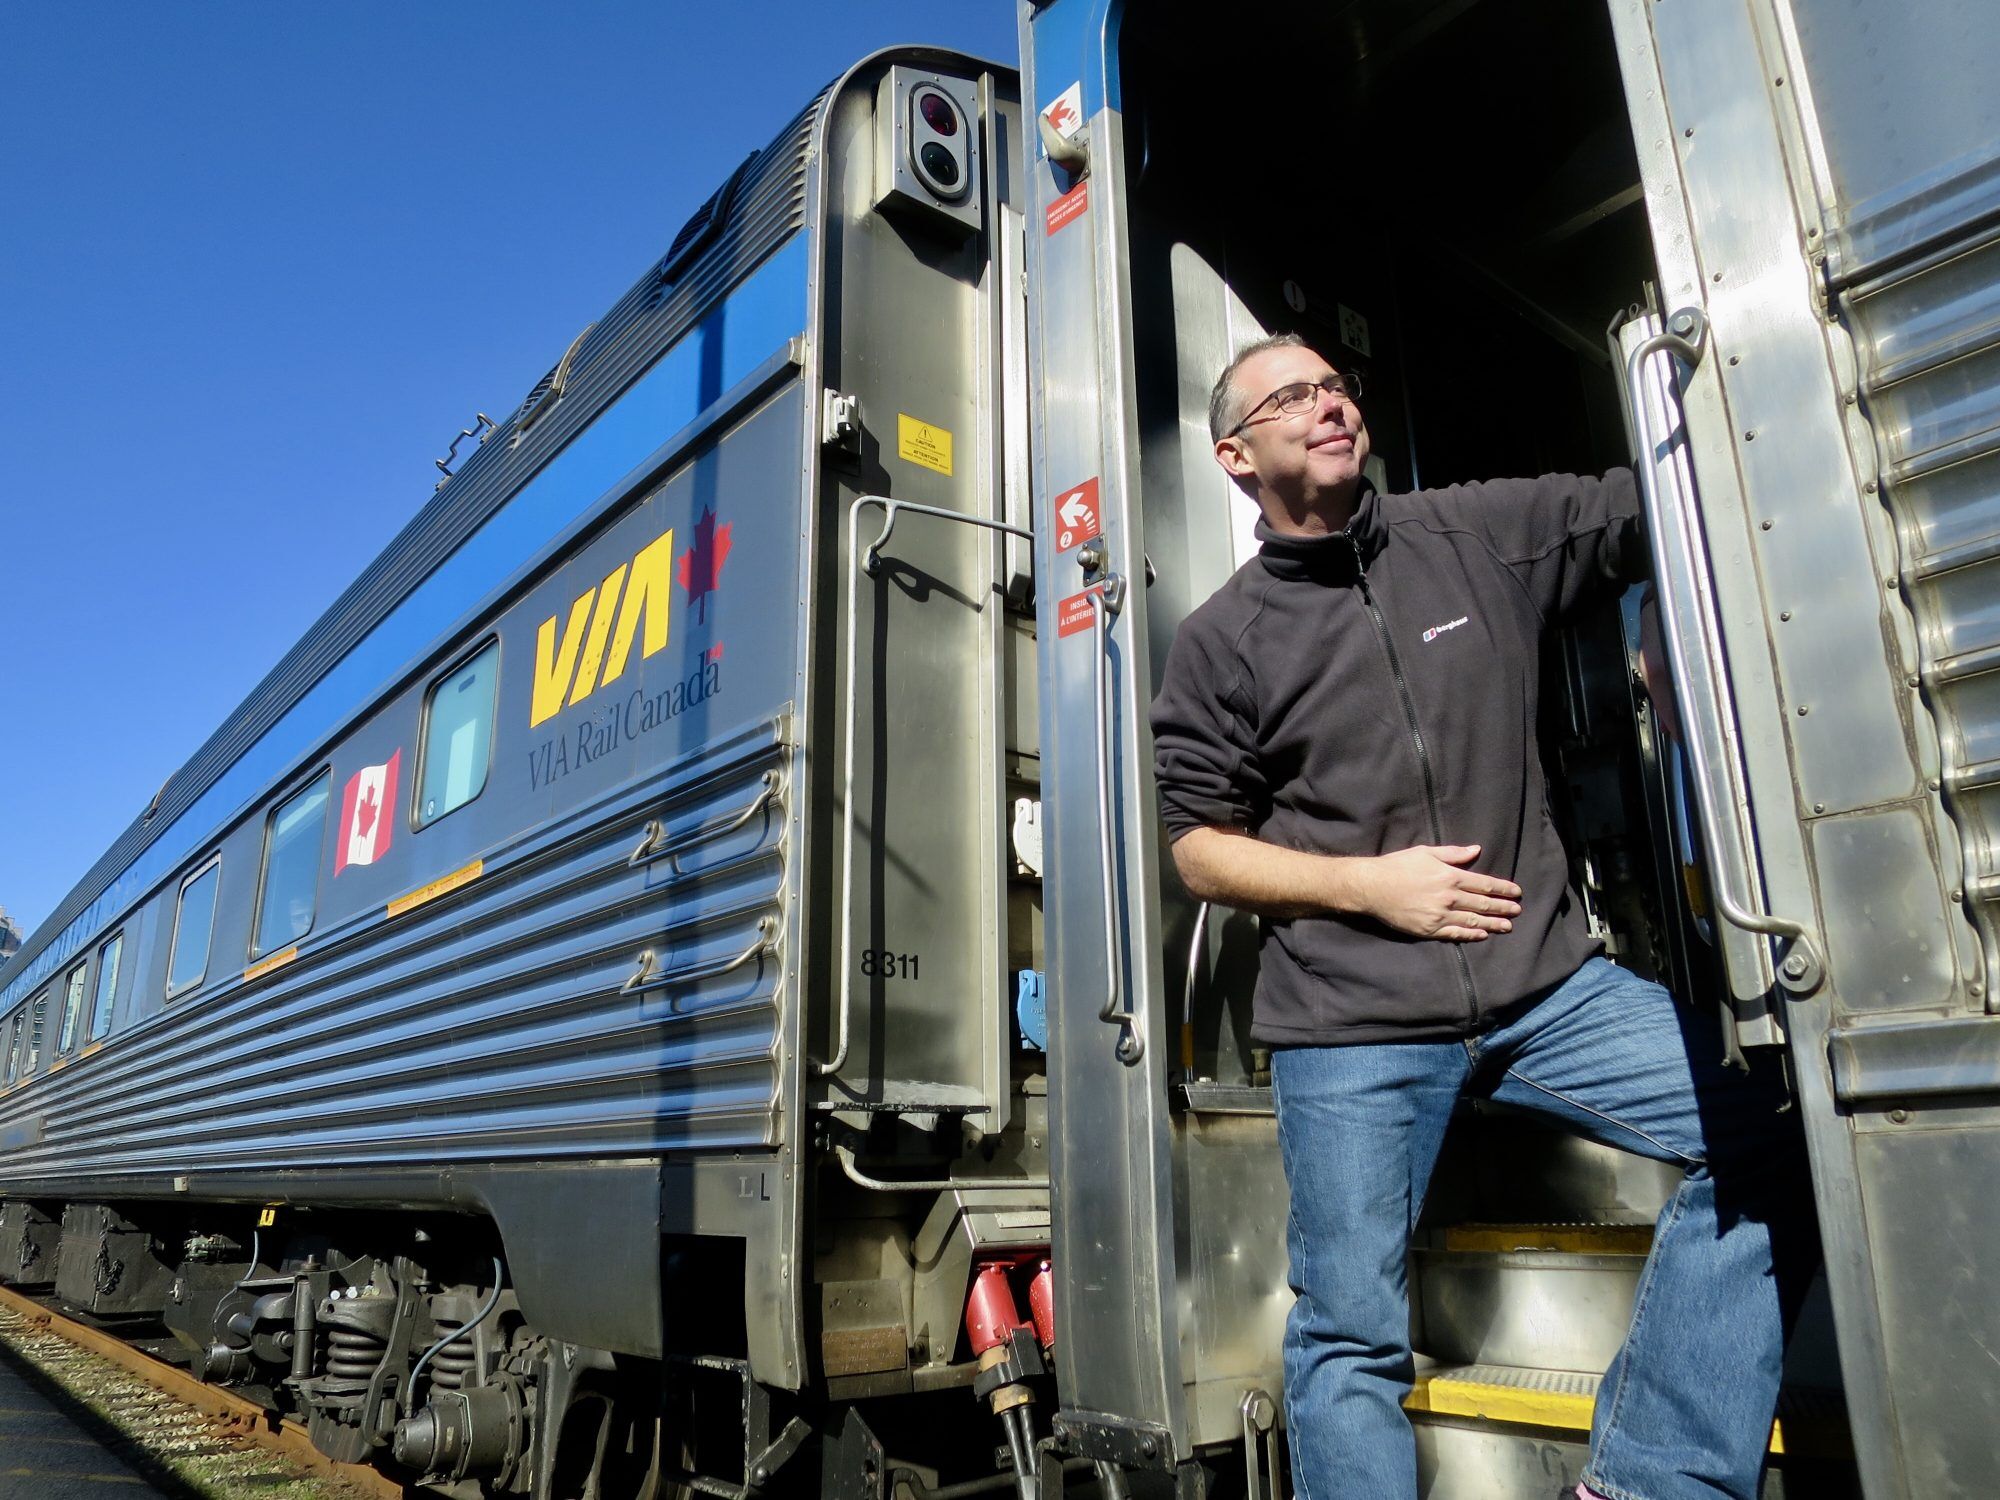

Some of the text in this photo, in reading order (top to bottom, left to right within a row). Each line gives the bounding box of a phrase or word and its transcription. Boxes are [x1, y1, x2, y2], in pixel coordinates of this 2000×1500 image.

[1047, 189, 1087, 220] EMERGENCY ACCESS
[913, 449, 939, 462] ATTENTION
[915, 438, 936, 449] CAUTION
[1070, 598, 1089, 611] INSID
[530, 528, 673, 728] VIA
[528, 650, 721, 792] VIA Rail Canada
[860, 949, 919, 980] 8311
[760, 1172, 771, 1201] L
